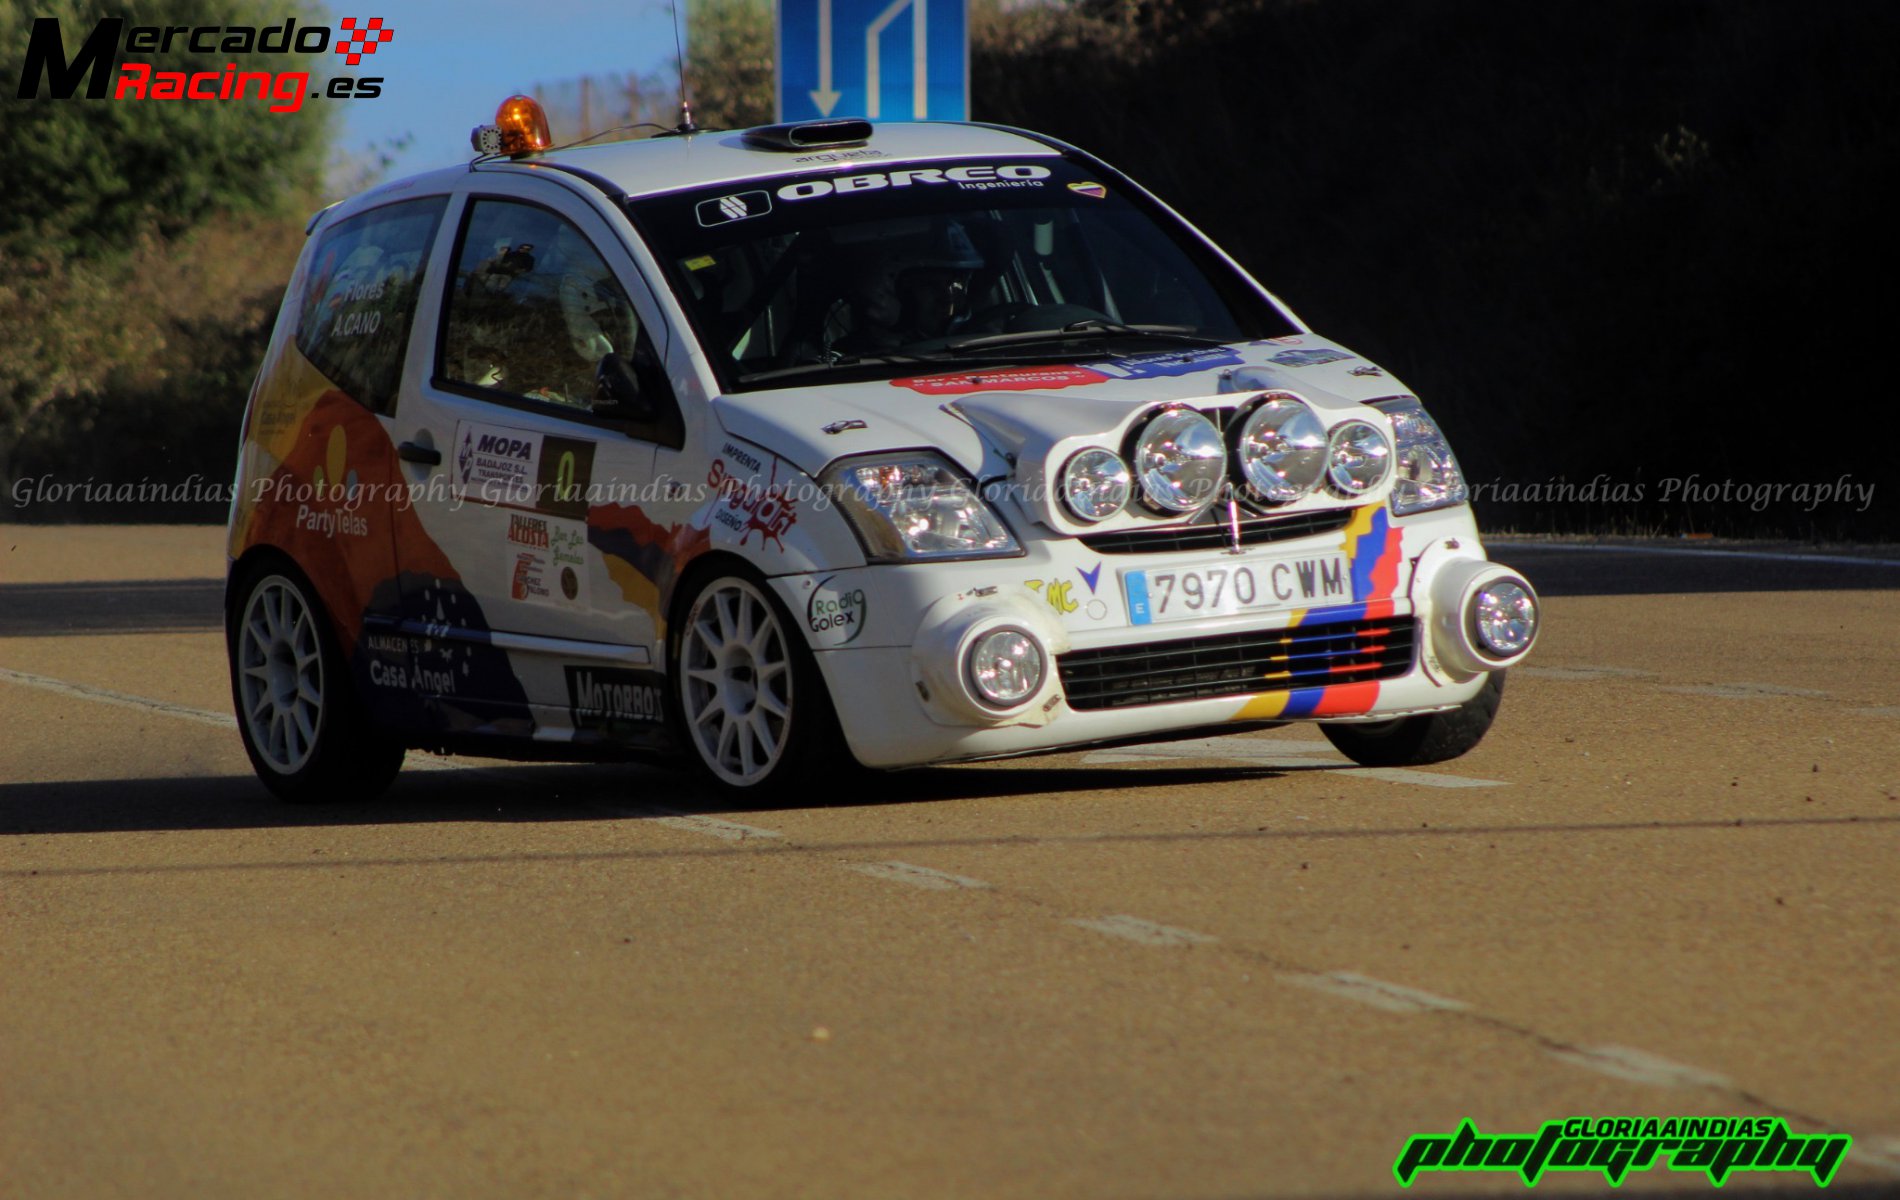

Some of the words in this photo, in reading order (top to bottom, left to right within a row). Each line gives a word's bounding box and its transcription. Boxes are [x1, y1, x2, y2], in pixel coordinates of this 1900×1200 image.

[777, 165, 1051, 200] OBREO
[343, 281, 384, 302] Flores
[477, 434, 532, 460] MOPA
[722, 442, 762, 473] IMPRENTA
[476, 457, 512, 472] BADAJOZ
[295, 504, 368, 539] PartyTelas
[715, 508, 742, 532] DISEÑO
[1154, 566, 1256, 614] 7970
[1271, 556, 1345, 601] CWM
[815, 588, 867, 615] Radio
[809, 610, 855, 632] Golex
[370, 659, 408, 688] Casa
